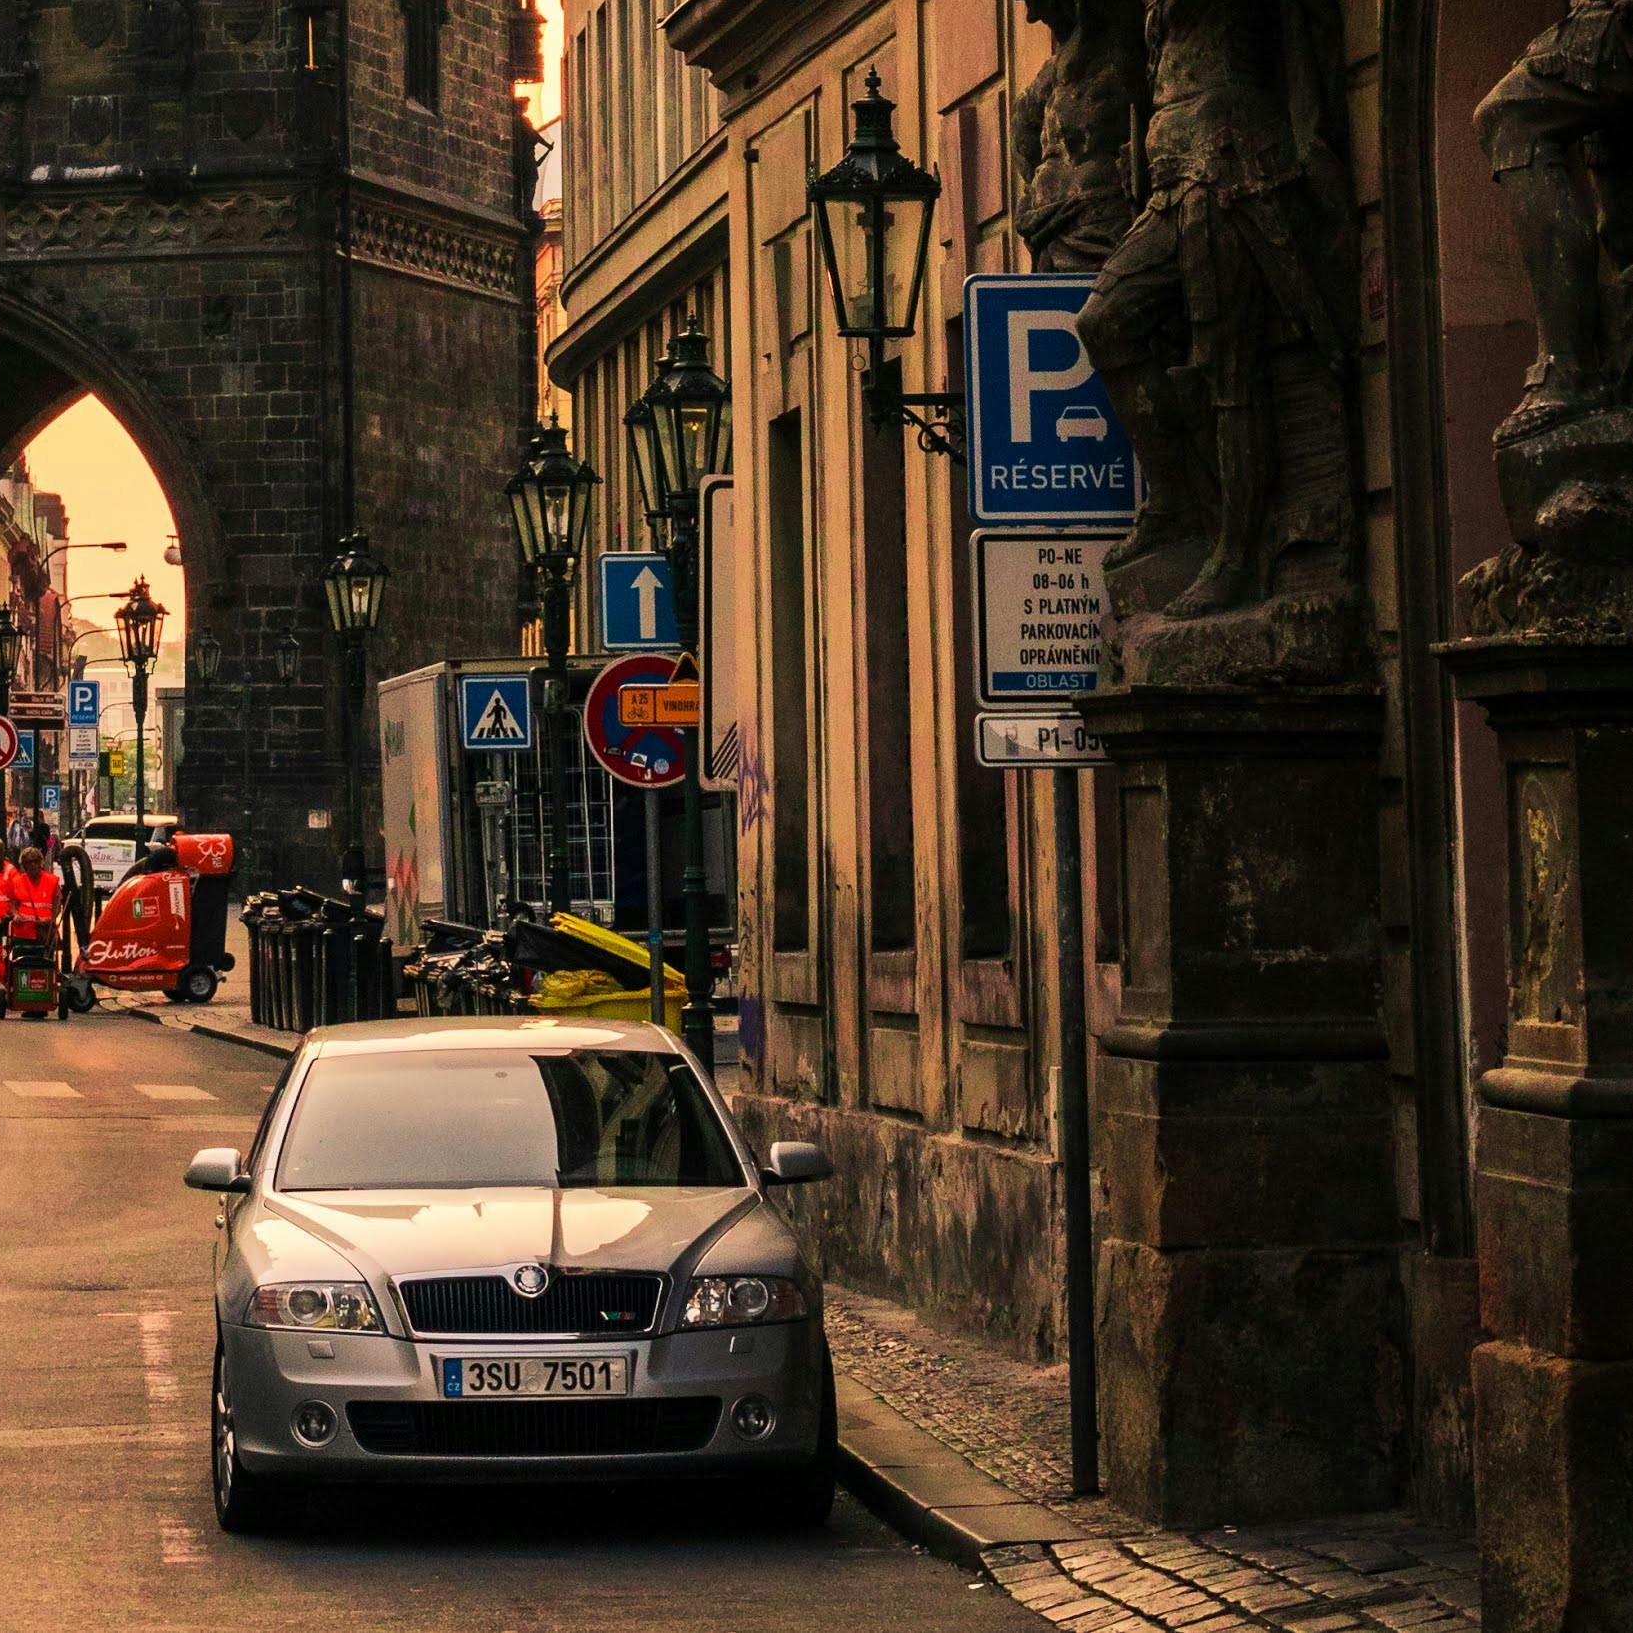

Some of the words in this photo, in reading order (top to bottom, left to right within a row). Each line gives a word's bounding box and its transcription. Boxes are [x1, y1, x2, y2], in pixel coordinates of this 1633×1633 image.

[1007, 309, 1095, 443] P
[991, 456, 1126, 490] RÉSERVÉ
[1038, 547, 1083, 566] PO-NE
[1032, 572, 1076, 591] 08-06
[1080, 572, 1090, 591] h
[1024, 598, 1033, 615] S
[1039, 594, 1100, 614] PLATNÝM
[1025, 674, 1089, 688] OBLAST
[74, 686, 93, 712] P
[87, 939, 158, 965] Glutton
[468, 1361, 522, 1392] 3SU
[542, 1360, 612, 1392] 7501
